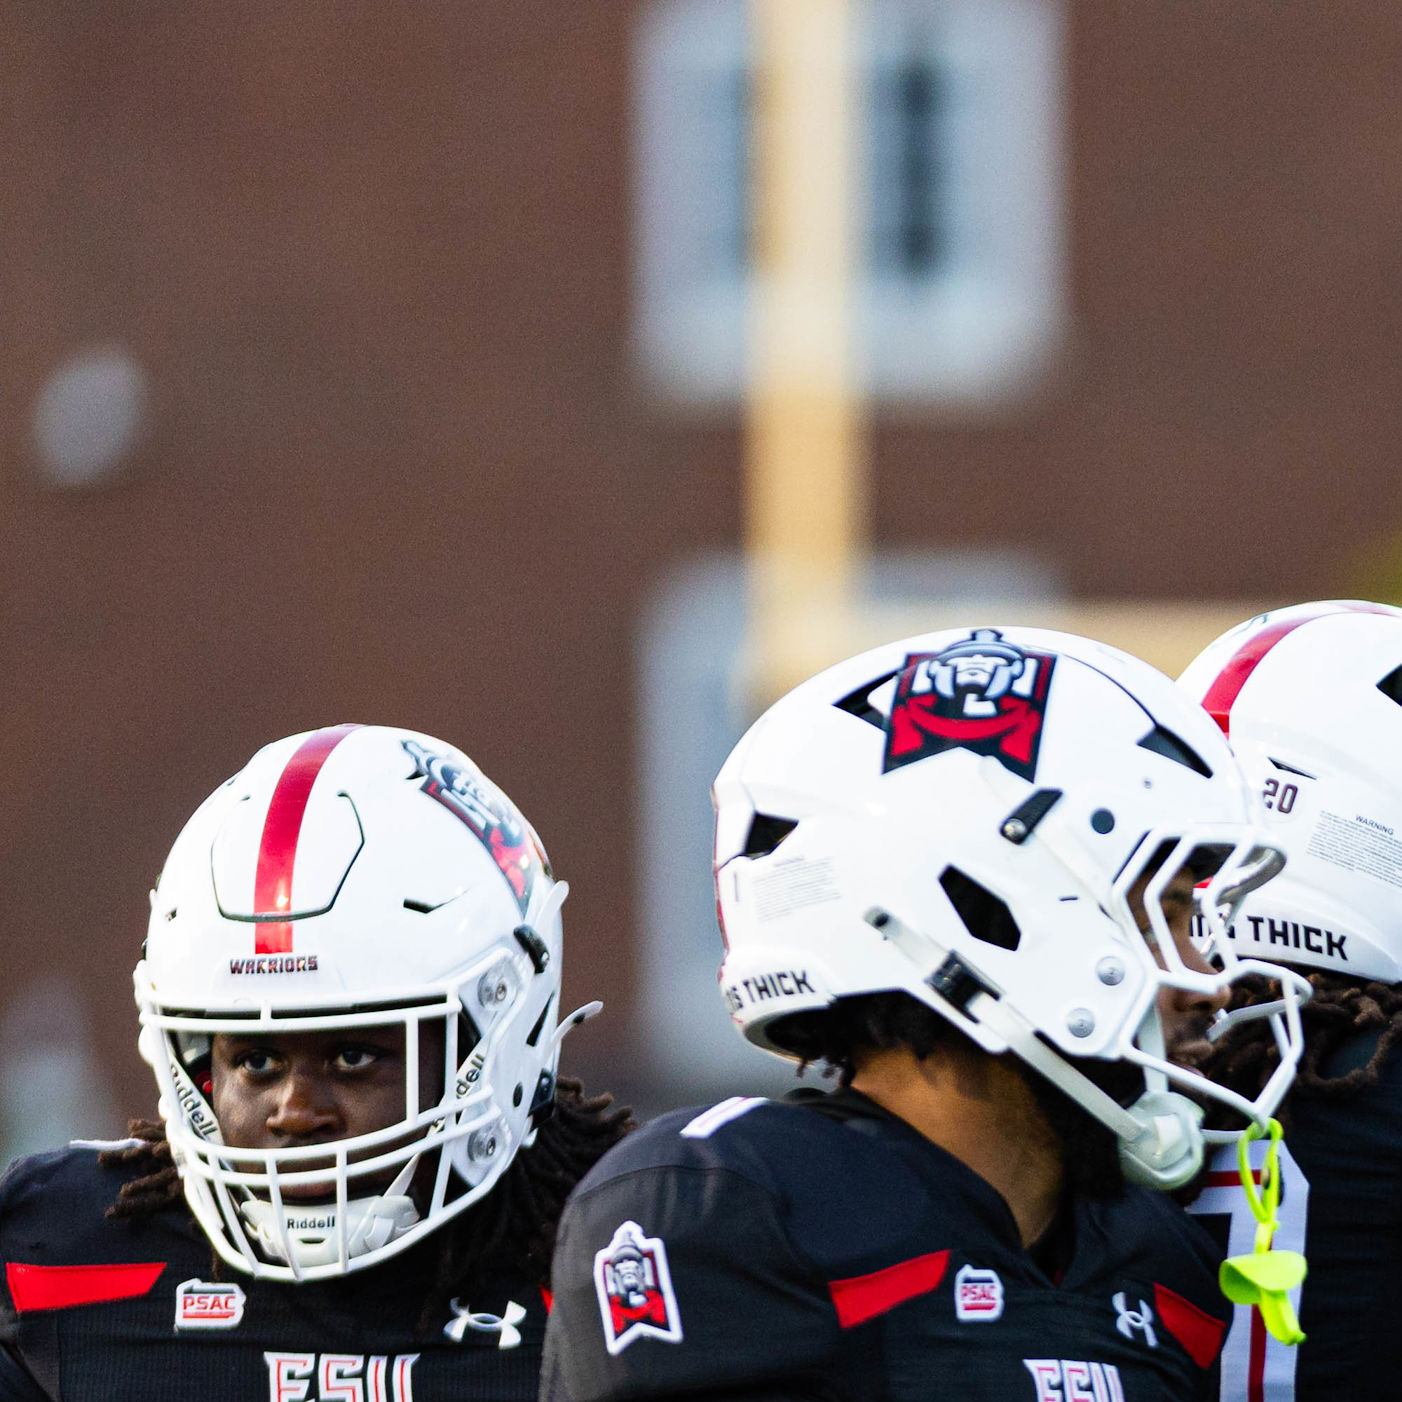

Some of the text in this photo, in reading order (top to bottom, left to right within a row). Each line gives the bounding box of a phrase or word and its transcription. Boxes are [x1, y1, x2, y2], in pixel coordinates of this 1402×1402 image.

[1263, 778, 1298, 814] 20
[1355, 814, 1395, 837] WARNING
[1246, 914, 1349, 961] THICK
[229, 955, 319, 975] WARRIORS
[743, 969, 816, 1003] THICK
[286, 1215, 336, 1230] Riddell
[183, 1295, 237, 1311] PSAC
